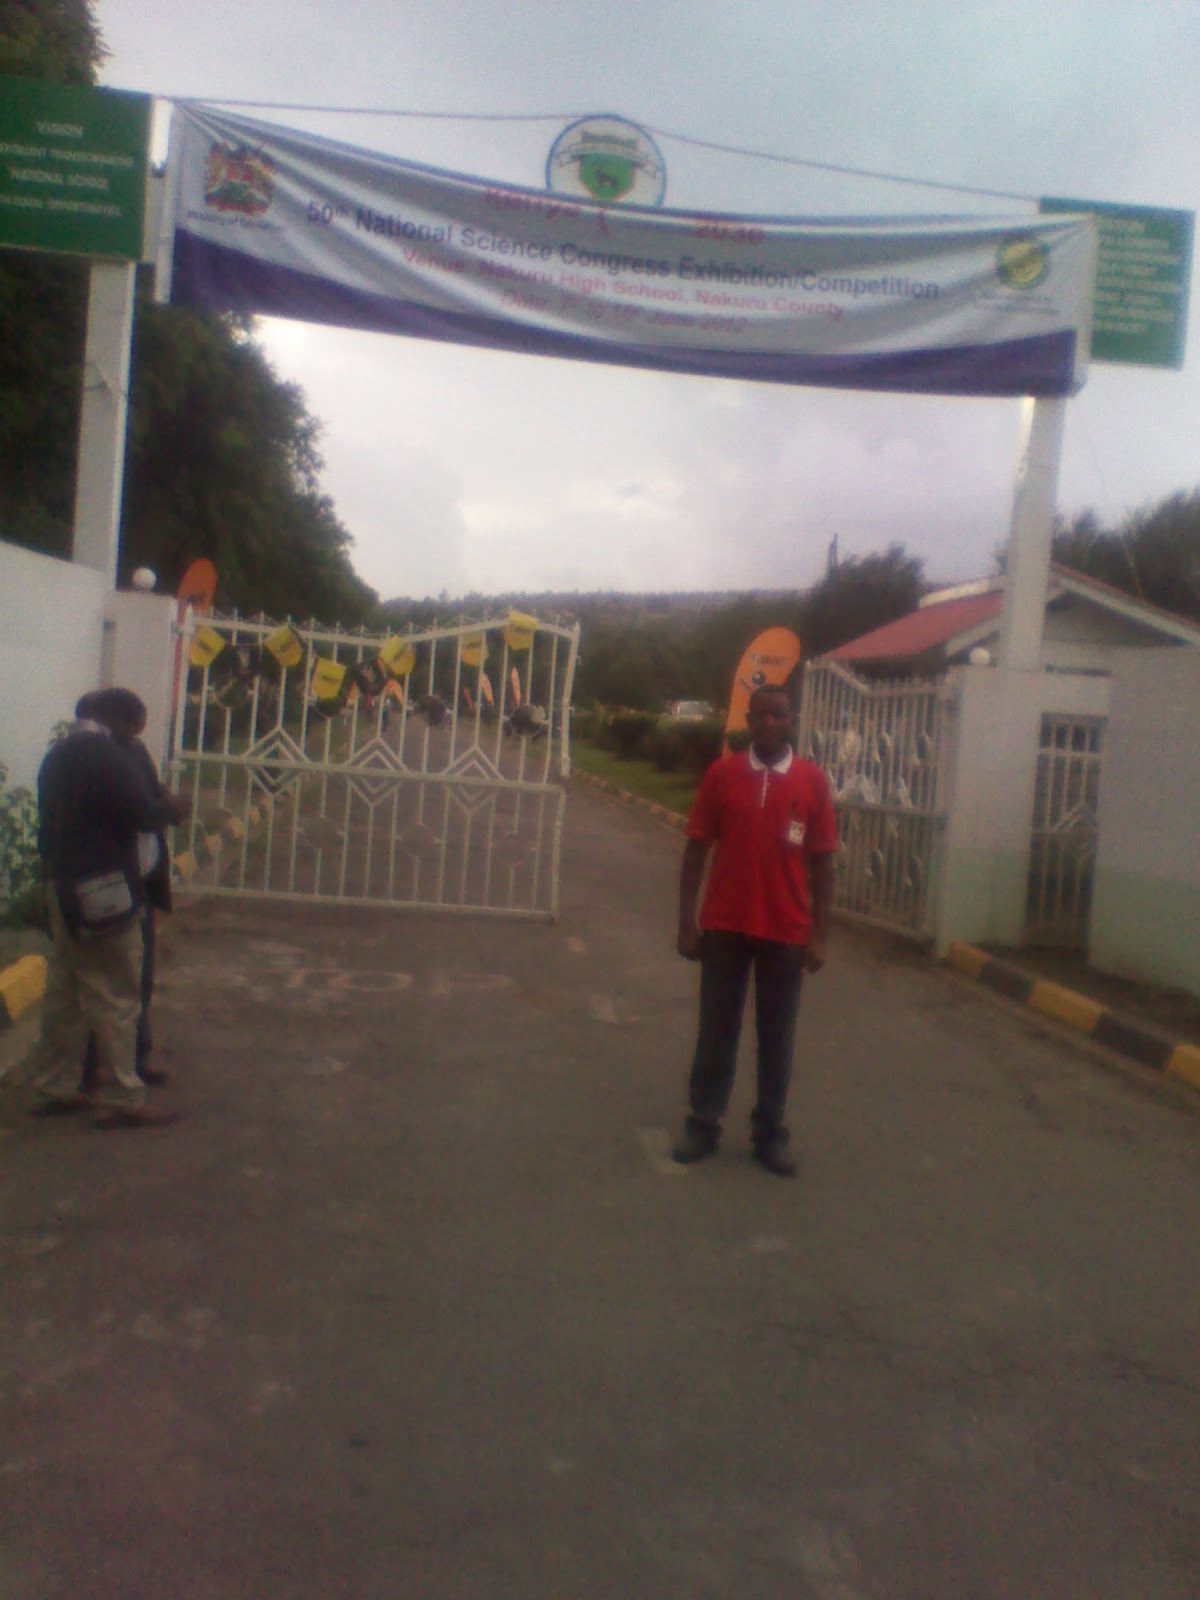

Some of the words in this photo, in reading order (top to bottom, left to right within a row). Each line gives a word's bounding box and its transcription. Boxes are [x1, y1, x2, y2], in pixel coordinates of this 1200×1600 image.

[356, 206, 453, 244] National
[460, 226, 552, 261] Science
[559, 241, 671, 276] Congress
[677, 255, 939, 300] Exhibition/Competition
[477, 259, 552, 284] Nakuru
[560, 272, 606, 295] High
[696, 288, 768, 311] Nakuru
[772, 295, 844, 321] County
